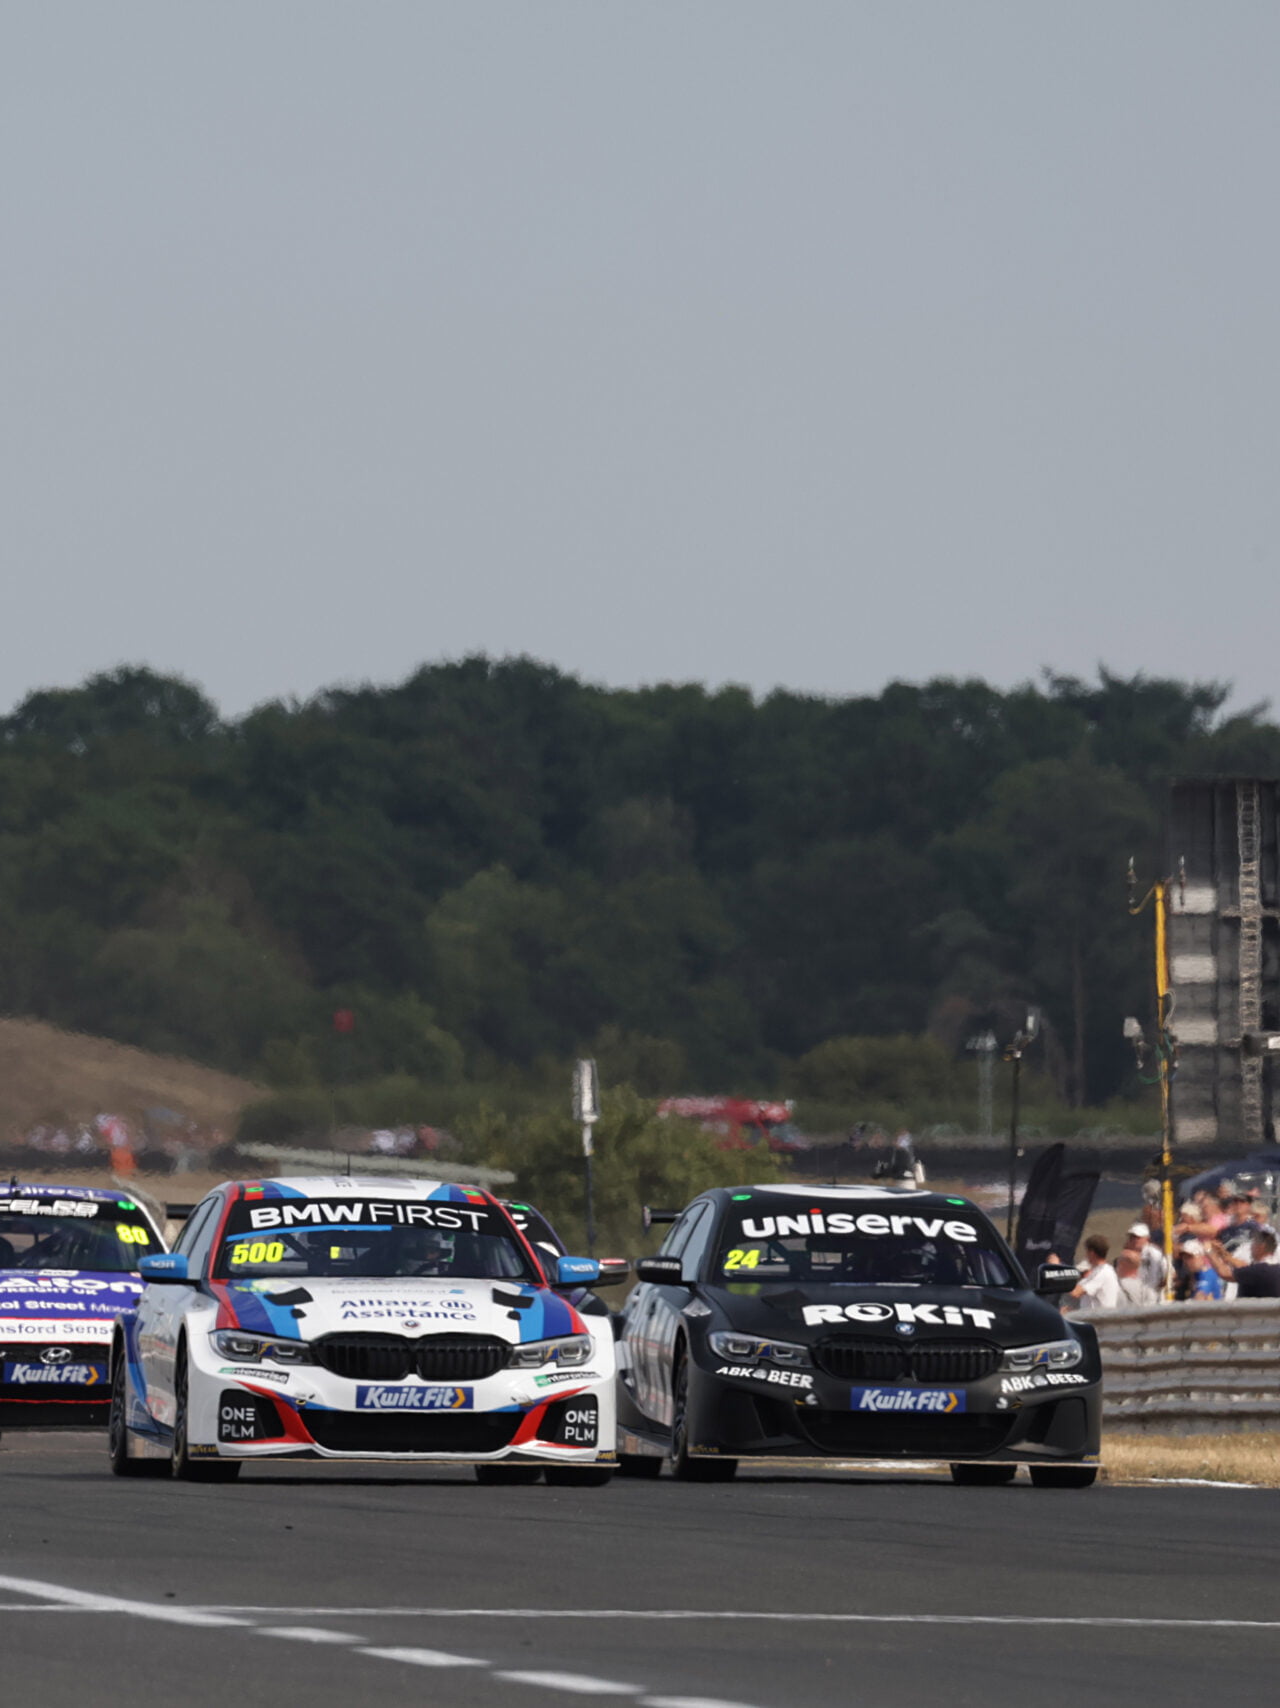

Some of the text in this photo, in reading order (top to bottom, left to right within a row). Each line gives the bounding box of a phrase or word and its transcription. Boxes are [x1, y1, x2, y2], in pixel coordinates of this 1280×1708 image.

[116, 1224, 150, 1246] 80
[231, 1242, 284, 1265] 500
[724, 1250, 760, 1270] 24
[25, 1300, 87, 1312] Street
[340, 1299, 433, 1309] Allianz
[342, 1308, 478, 1321] Assistance
[62, 1324, 114, 1335] Sens
[716, 1366, 814, 1389] ABK BEER
[1001, 1373, 1089, 1393] ABK BEER
[221, 1406, 256, 1422] ONE
[565, 1409, 597, 1424] ONE
[221, 1424, 255, 1439] PLM
[565, 1426, 595, 1441] PLM
